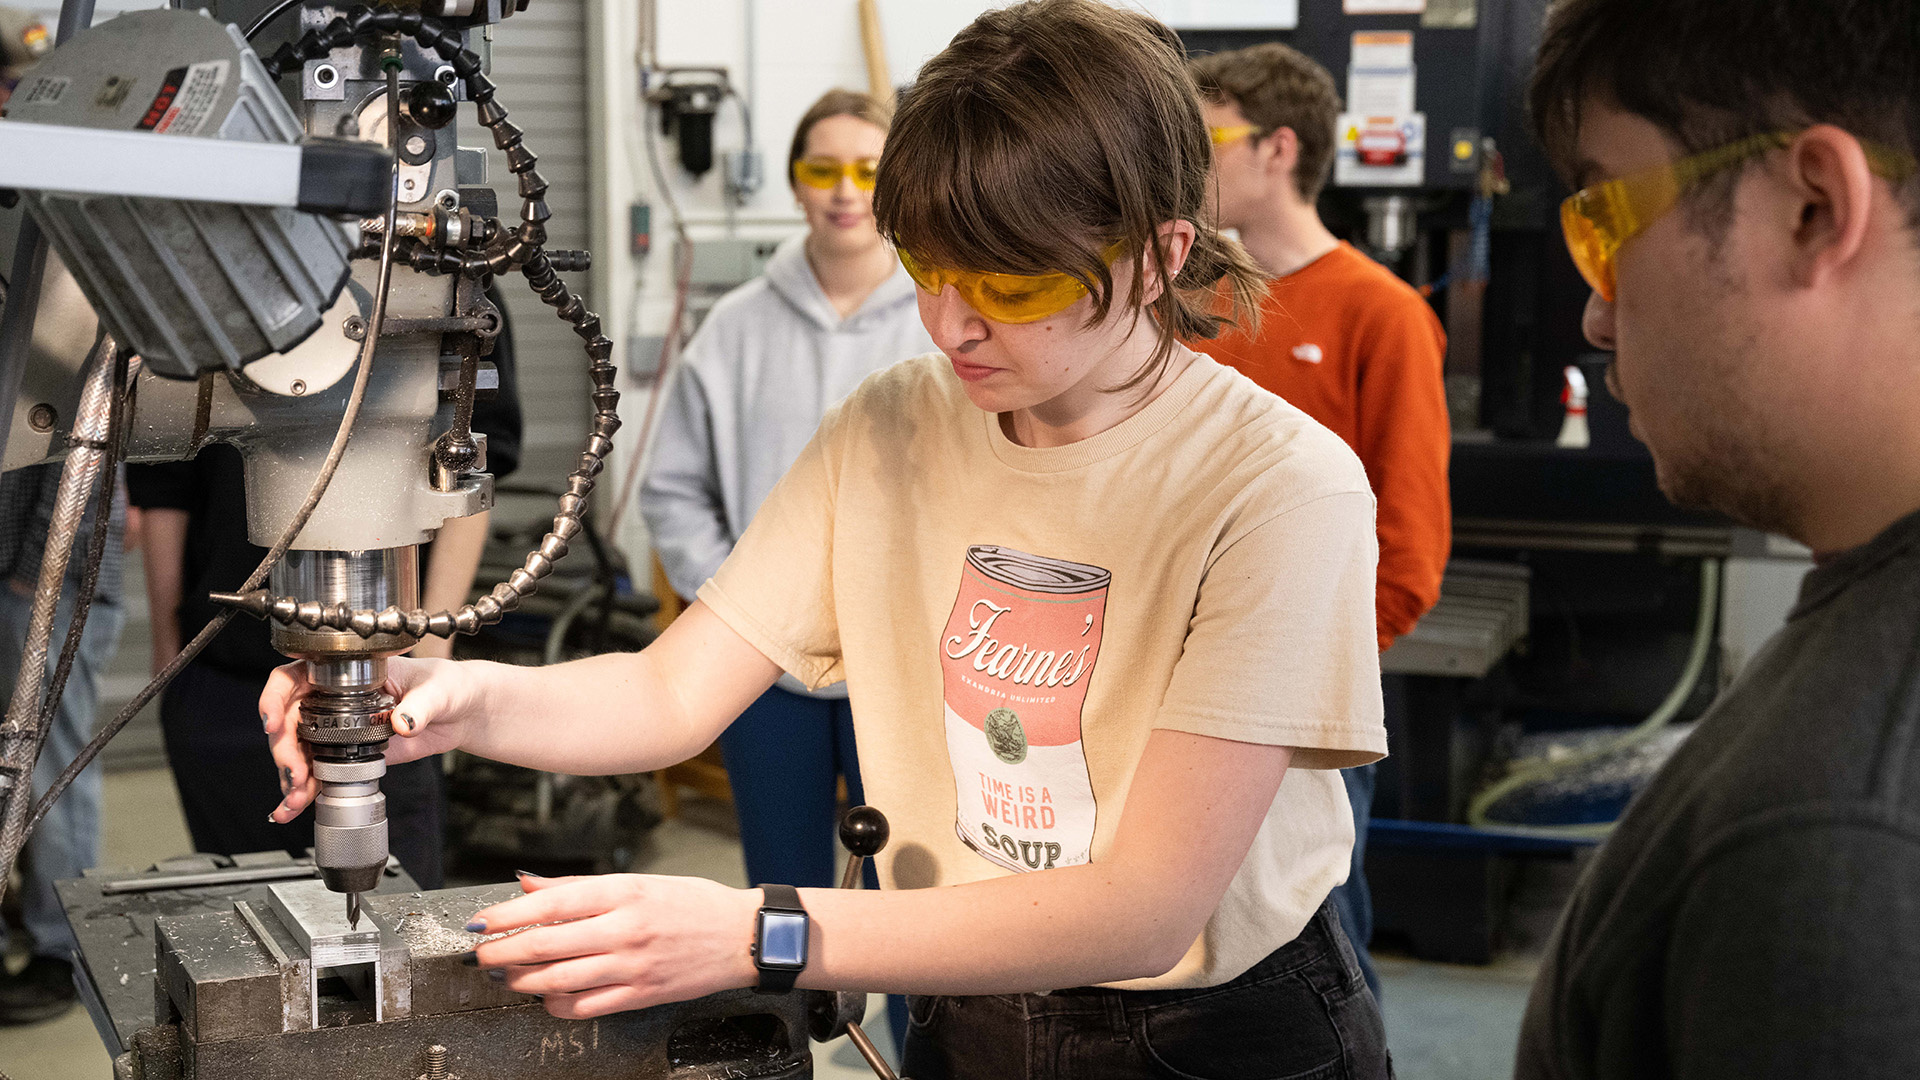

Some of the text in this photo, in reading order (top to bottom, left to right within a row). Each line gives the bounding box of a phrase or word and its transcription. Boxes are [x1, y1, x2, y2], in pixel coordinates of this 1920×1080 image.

[961, 674, 1056, 704] EXANDRIA UNLIMITED
[323, 717, 360, 728] EASY
[979, 772, 1052, 804] TIME IS A
[981, 789, 1055, 830] WEIRD
[981, 822, 1061, 870] SOUP
